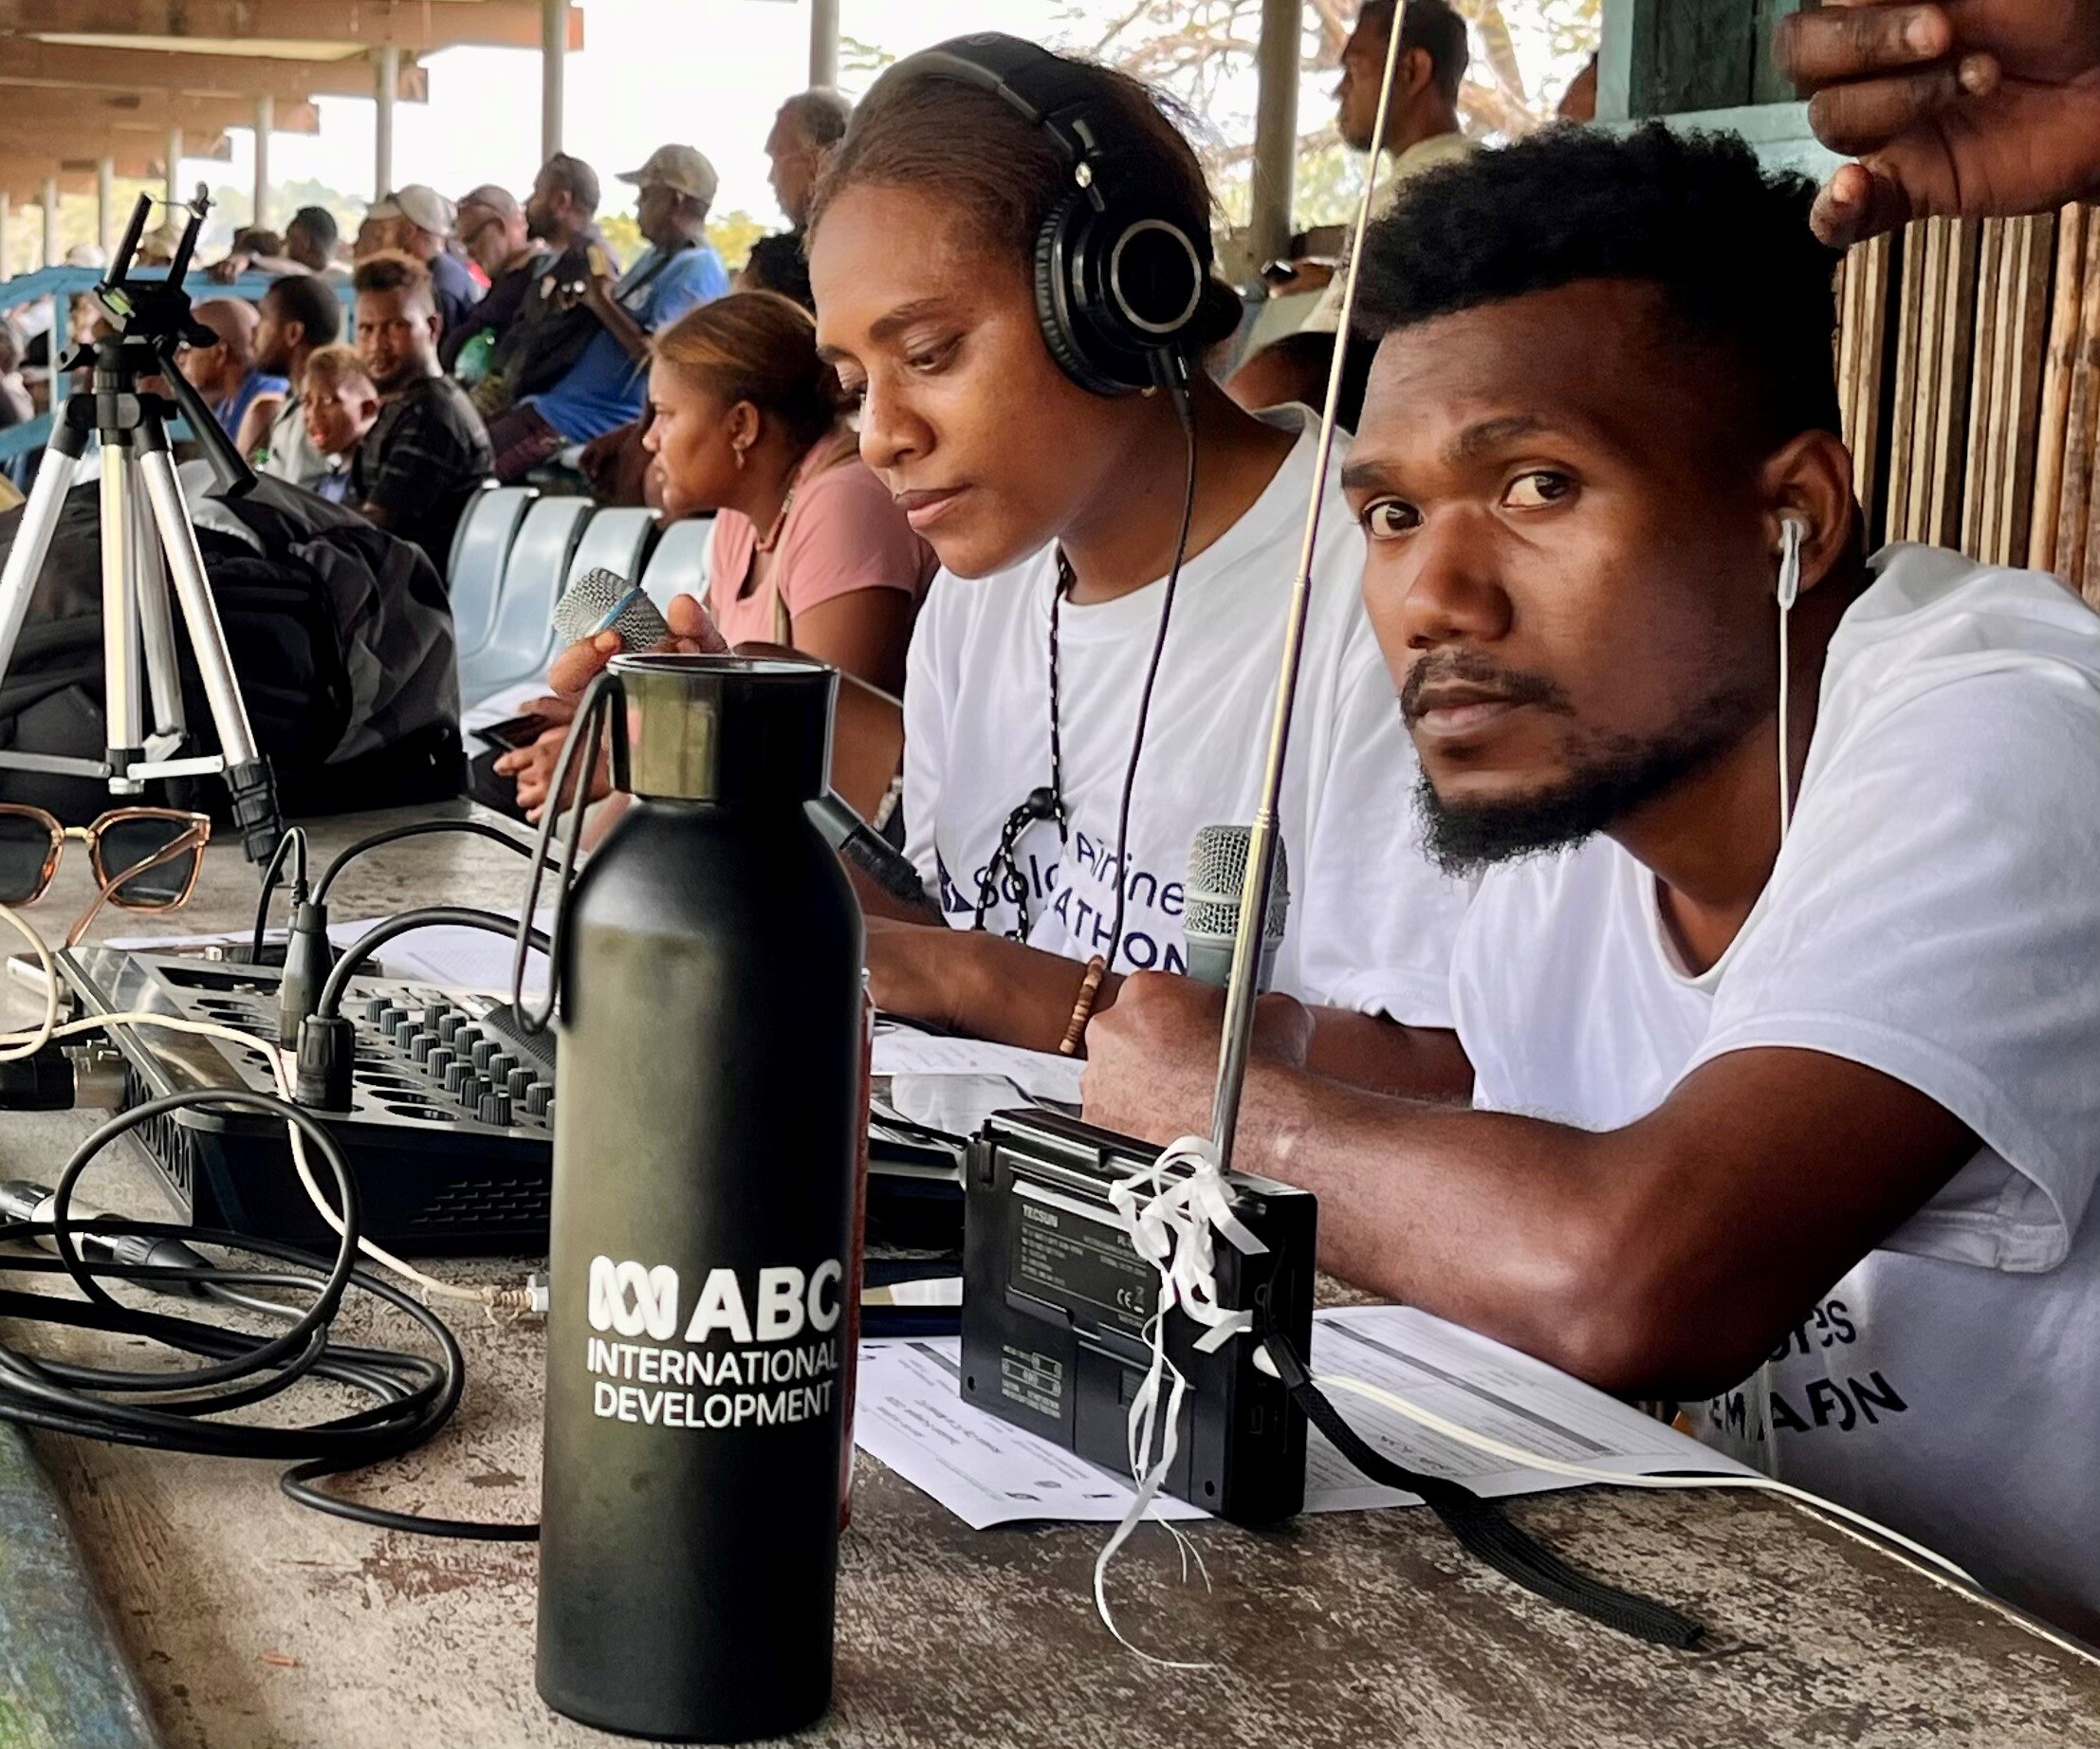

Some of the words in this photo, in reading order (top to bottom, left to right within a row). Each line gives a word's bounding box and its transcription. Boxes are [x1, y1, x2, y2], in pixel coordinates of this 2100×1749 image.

[683, 1258, 842, 1344] ABC
[586, 1336, 838, 1387] INTERNATIONAL
[594, 1379, 834, 1428] DEVELOPMENT
